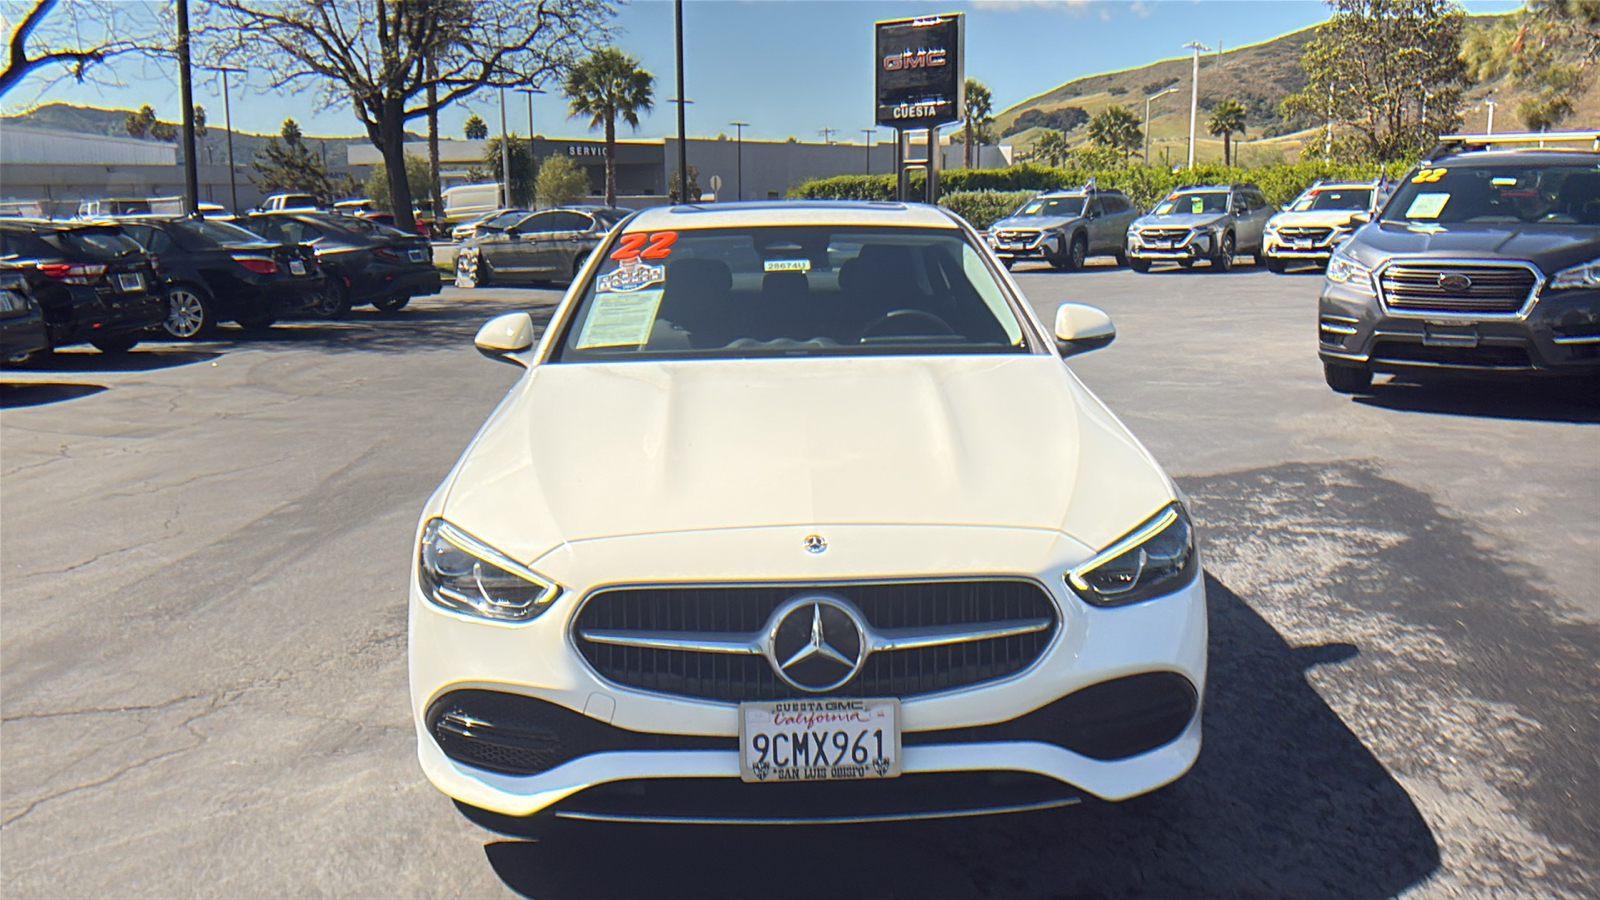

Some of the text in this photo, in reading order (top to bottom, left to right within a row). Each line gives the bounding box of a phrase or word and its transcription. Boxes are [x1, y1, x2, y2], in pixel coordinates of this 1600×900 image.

[883, 47, 946, 71] GMC
[893, 105, 936, 119] CUESTA
[569, 146, 608, 156] SERVIC
[1411, 168, 1448, 184] 22
[609, 231, 678, 260] 22
[775, 701, 864, 712] CUESTA GMC
[774, 711, 870, 729] California
[752, 728, 883, 767] 9CMX961
[778, 764, 865, 780] SAN LUIS OBISPO
